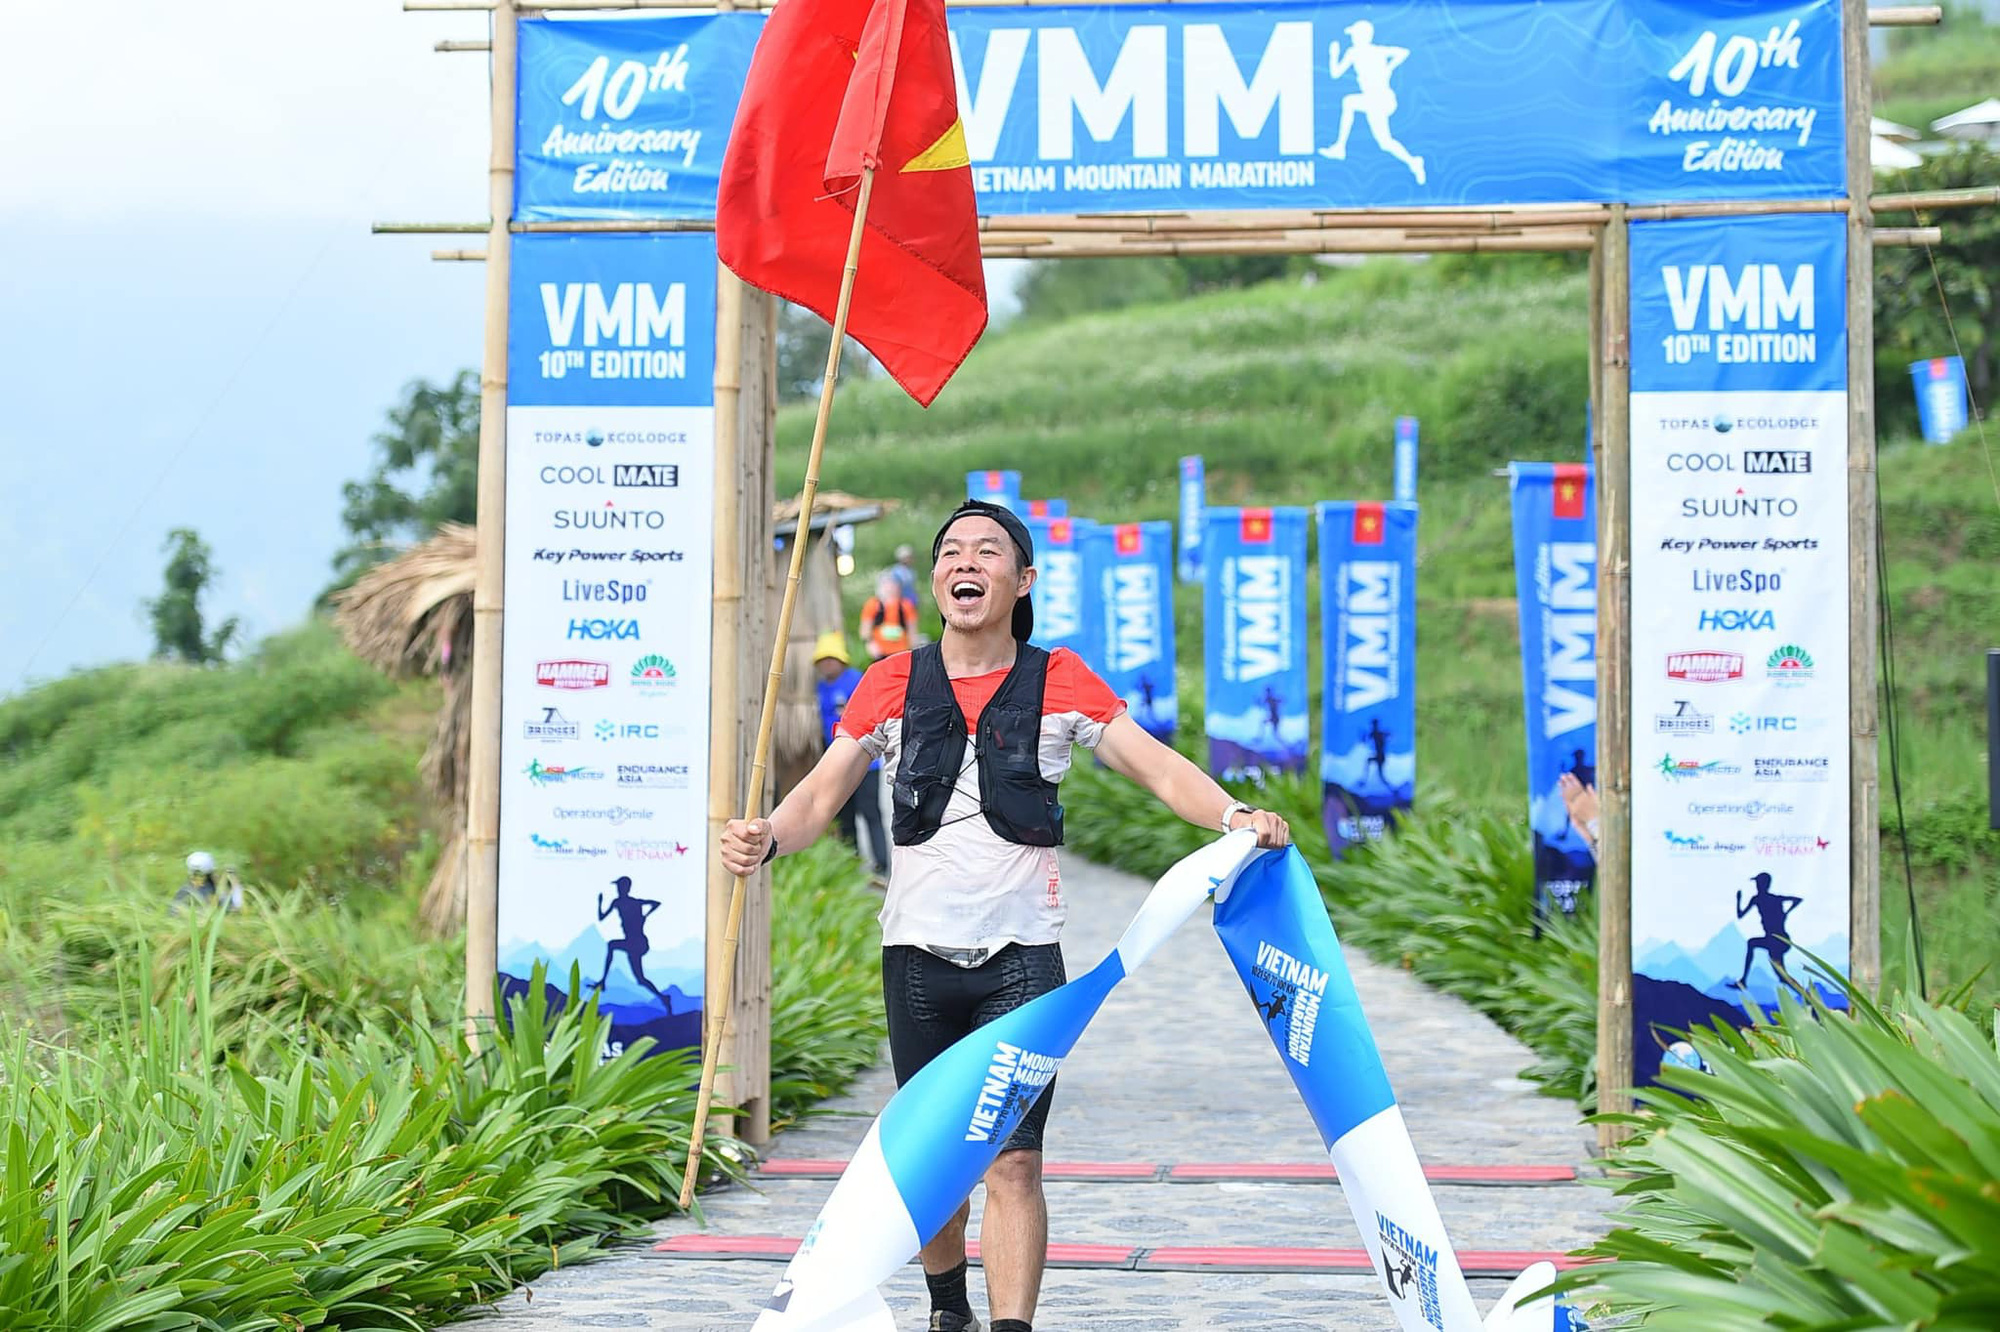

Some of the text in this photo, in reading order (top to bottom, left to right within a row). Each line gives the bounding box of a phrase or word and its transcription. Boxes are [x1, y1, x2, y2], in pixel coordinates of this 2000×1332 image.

[1668, 18, 1802, 97] 10th
[562, 43, 689, 120] 10th
[949, 21, 1315, 162] VMM
[1648, 99, 1816, 147] Anniversary
[541, 123, 701, 167] Anniversary
[1682, 136, 1784, 172] Edition
[573, 159, 668, 193] Edition
[1064, 163, 1181, 191] MOUNTAIN
[1190, 161, 1315, 188] MARATHON
[1661, 264, 1814, 331] VMM
[539, 282, 686, 347] VMM
[1662, 333, 1816, 364] 10TH EDITION
[539, 350, 686, 379] 10TH EDITION
[534, 432, 687, 443] TOPAS ECOLODGE
[1660, 418, 1819, 430] TOPAS ECOLODGE
[540, 465, 677, 487] COOL MATE
[1667, 451, 1811, 473] COOL MATE
[554, 510, 665, 529] SUUNTO
[1682, 498, 1798, 517] SUUNTO
[533, 549, 684, 564] Key Power Sports
[1661, 538, 1818, 553] Key Power Sports
[562, 579, 647, 604] LiveSpo
[1693, 569, 1781, 593] LiveSpo
[567, 618, 640, 640] HOKA
[1115, 564, 1153, 672] VMM
[1237, 555, 1281, 683] VMM
[1699, 609, 1775, 631] HOKA
[1346, 561, 1390, 713] VMM
[1549, 541, 1596, 740] VMM
[538, 662, 609, 680] HAMMER
[1669, 655, 1742, 673] HAMMER
[542, 707, 557, 723] 7
[1674, 701, 1688, 717] 7
[1757, 717, 1797, 730] IRC
[621, 725, 659, 738] IRC
[617, 765, 688, 774] ENDURANCE
[1755, 759, 1828, 767] ENDURANCE
[618, 775, 643, 783] ASIA
[1256, 940, 1329, 996] VIETNAM
[1289, 988, 1309, 1061] MARATHON
[1298, 993, 1321, 1067] MOUNTAIN
[1019, 1050, 1062, 1072] MOUNT
[965, 1041, 1021, 1141] VIETNAM
[1375, 1209, 1438, 1271] VIETNAM
[1417, 1262, 1435, 1325] MARATHON
[1427, 1269, 1444, 1331] MOUNTAIN
